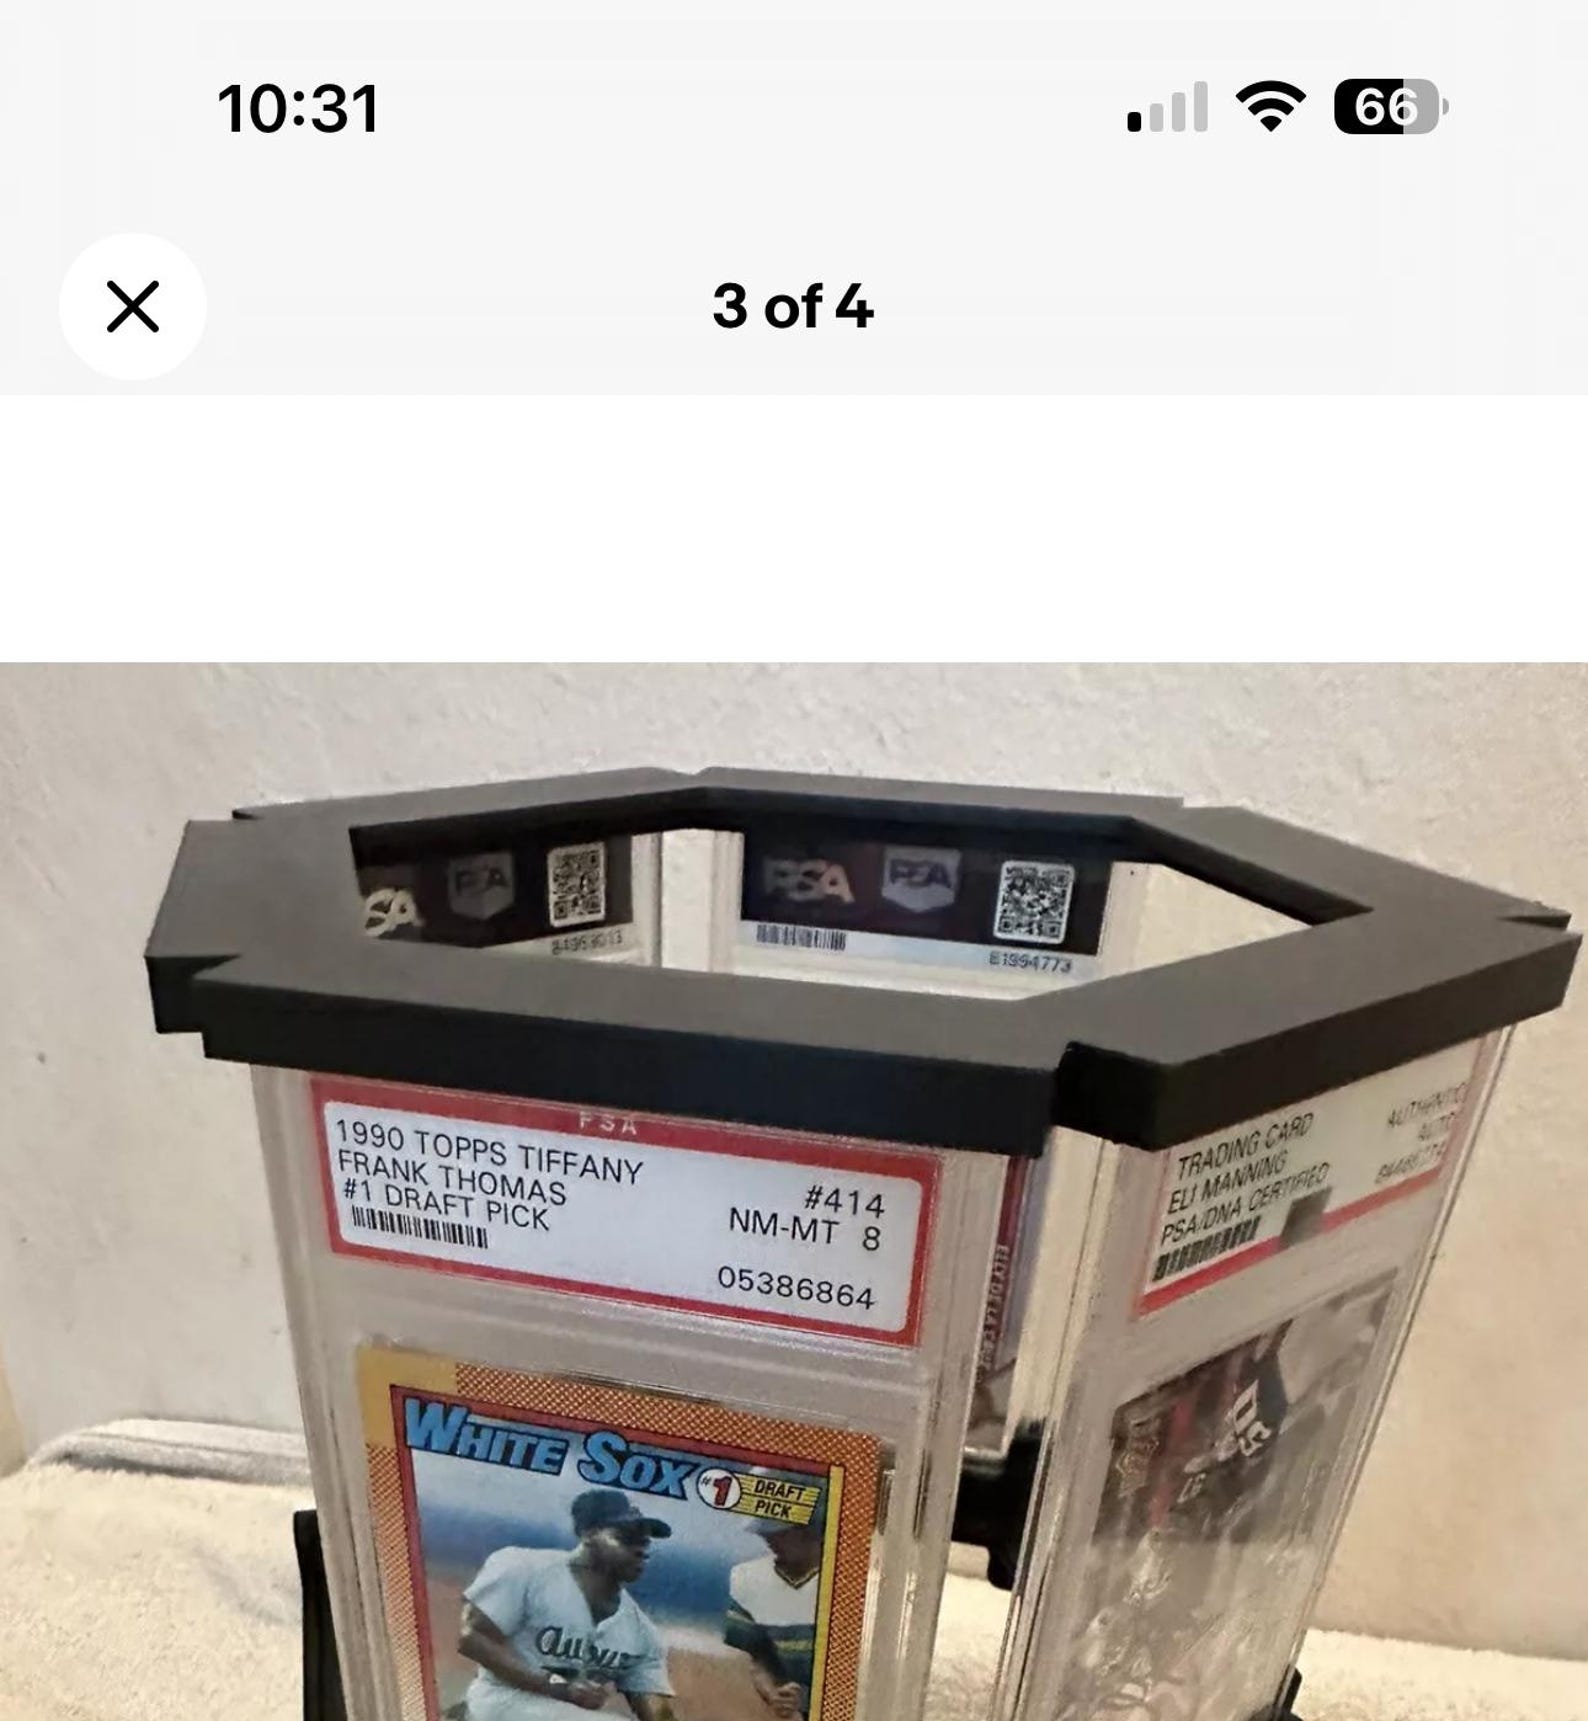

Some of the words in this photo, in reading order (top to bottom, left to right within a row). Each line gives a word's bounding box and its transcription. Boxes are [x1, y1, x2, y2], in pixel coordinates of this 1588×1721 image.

[579, 1111, 636, 1135] PSA
[1178, 1130, 1261, 1181] TRADING
[1265, 1112, 1314, 1149] CARD
[337, 1119, 404, 1151] 1990
[414, 1130, 507, 1166] TOPPS
[518, 1144, 643, 1185] TIFFANY
[338, 1150, 429, 1186] FRANK
[439, 1164, 567, 1206] THOMAS
[1168, 1183, 1198, 1215] ELI
[1201, 1149, 1288, 1202] MANNING
[1249, 1162, 1330, 1212] CERTIFIED
[343, 1177, 371, 1201] #1
[386, 1184, 474, 1218] DRAFT
[486, 1201, 550, 1231] PICK
[805, 1185, 885, 1219] #414
[729, 1207, 839, 1245] NM-MT
[862, 1226, 881, 1251] 8
[718, 1266, 875, 1311] 05386864
[754, 1480, 806, 1500] DRAFT
[755, 1500, 793, 1518] PICK
